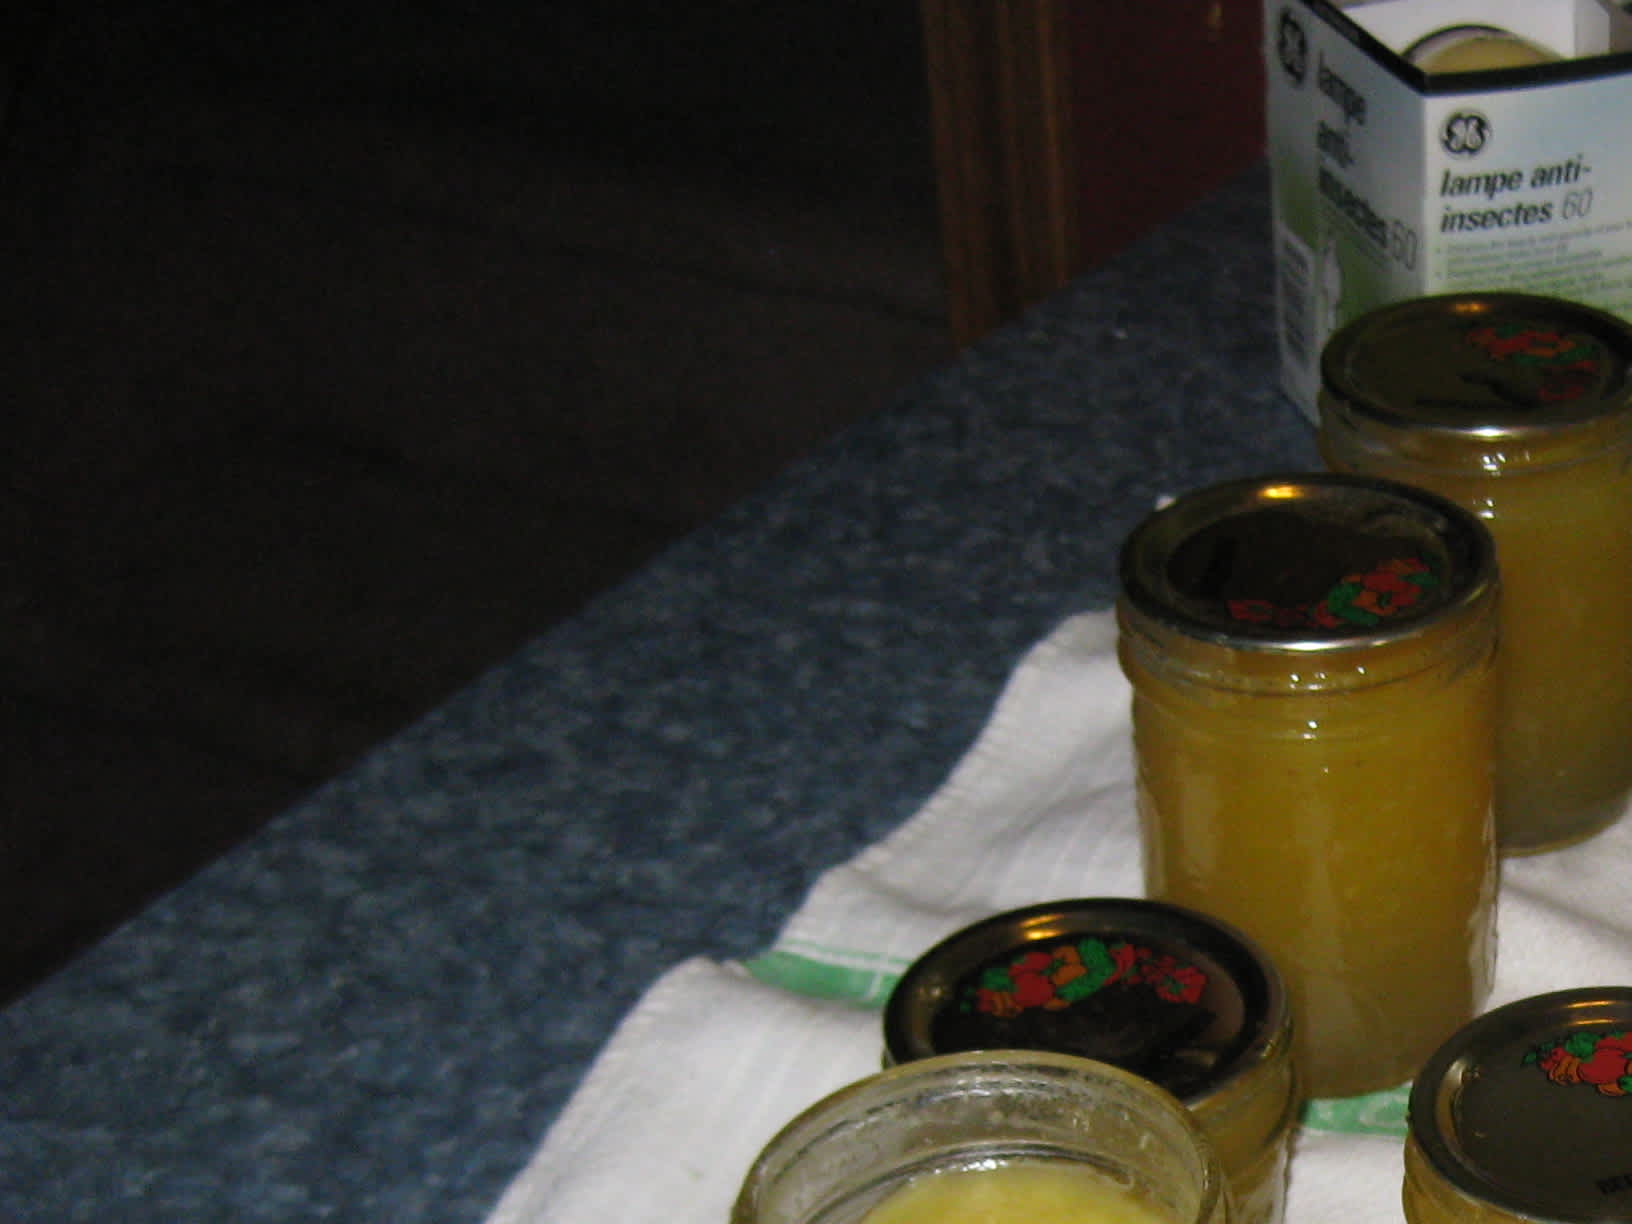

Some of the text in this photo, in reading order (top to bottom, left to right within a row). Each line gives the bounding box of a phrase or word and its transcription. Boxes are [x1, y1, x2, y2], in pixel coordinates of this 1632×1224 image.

[1440, 152, 1592, 200] lampe anti-
[1440, 188, 1593, 233] insectes 60
